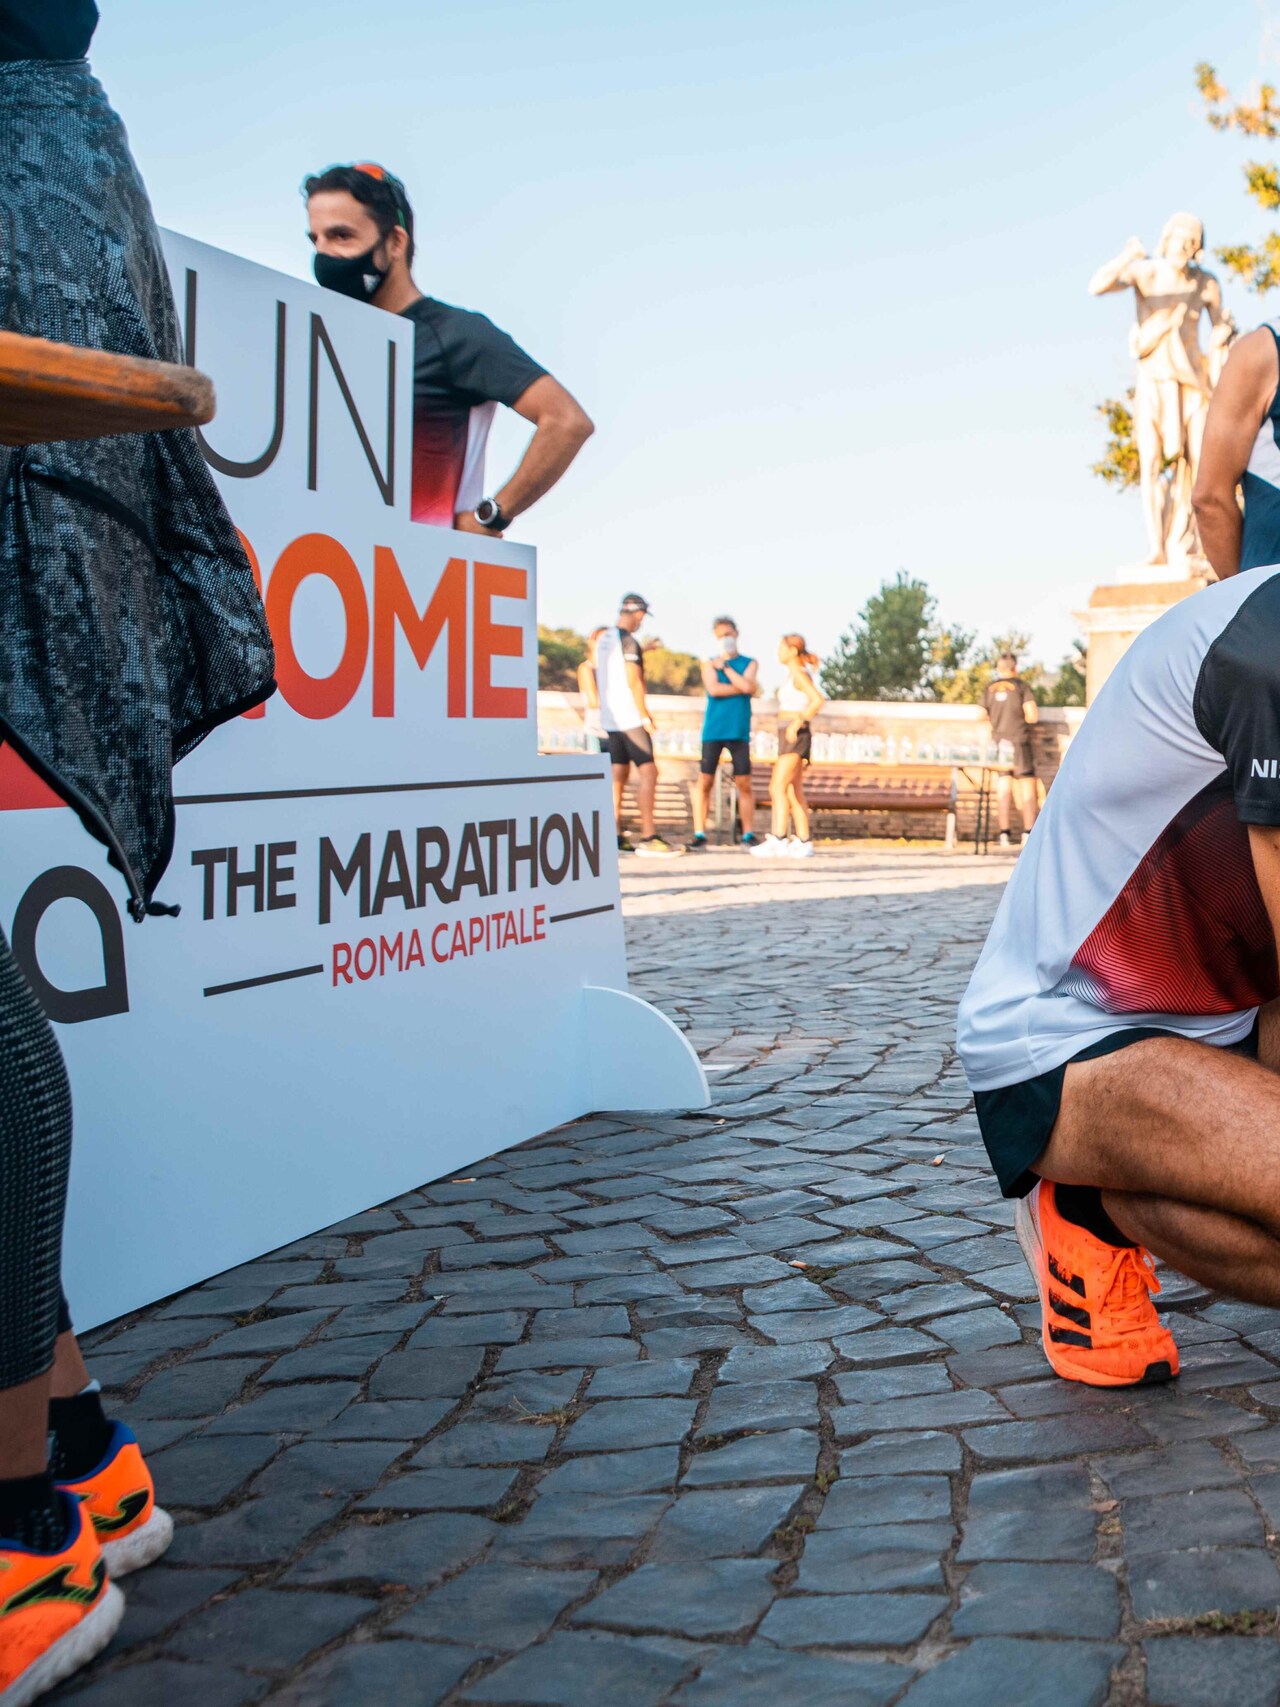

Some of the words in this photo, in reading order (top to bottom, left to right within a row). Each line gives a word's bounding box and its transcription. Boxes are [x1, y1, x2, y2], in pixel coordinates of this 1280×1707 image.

[191, 840, 297, 921] THE
[318, 810, 600, 925] MARATHON
[332, 928, 425, 988] ROMA
[431, 904, 546, 963] CAPITALE
